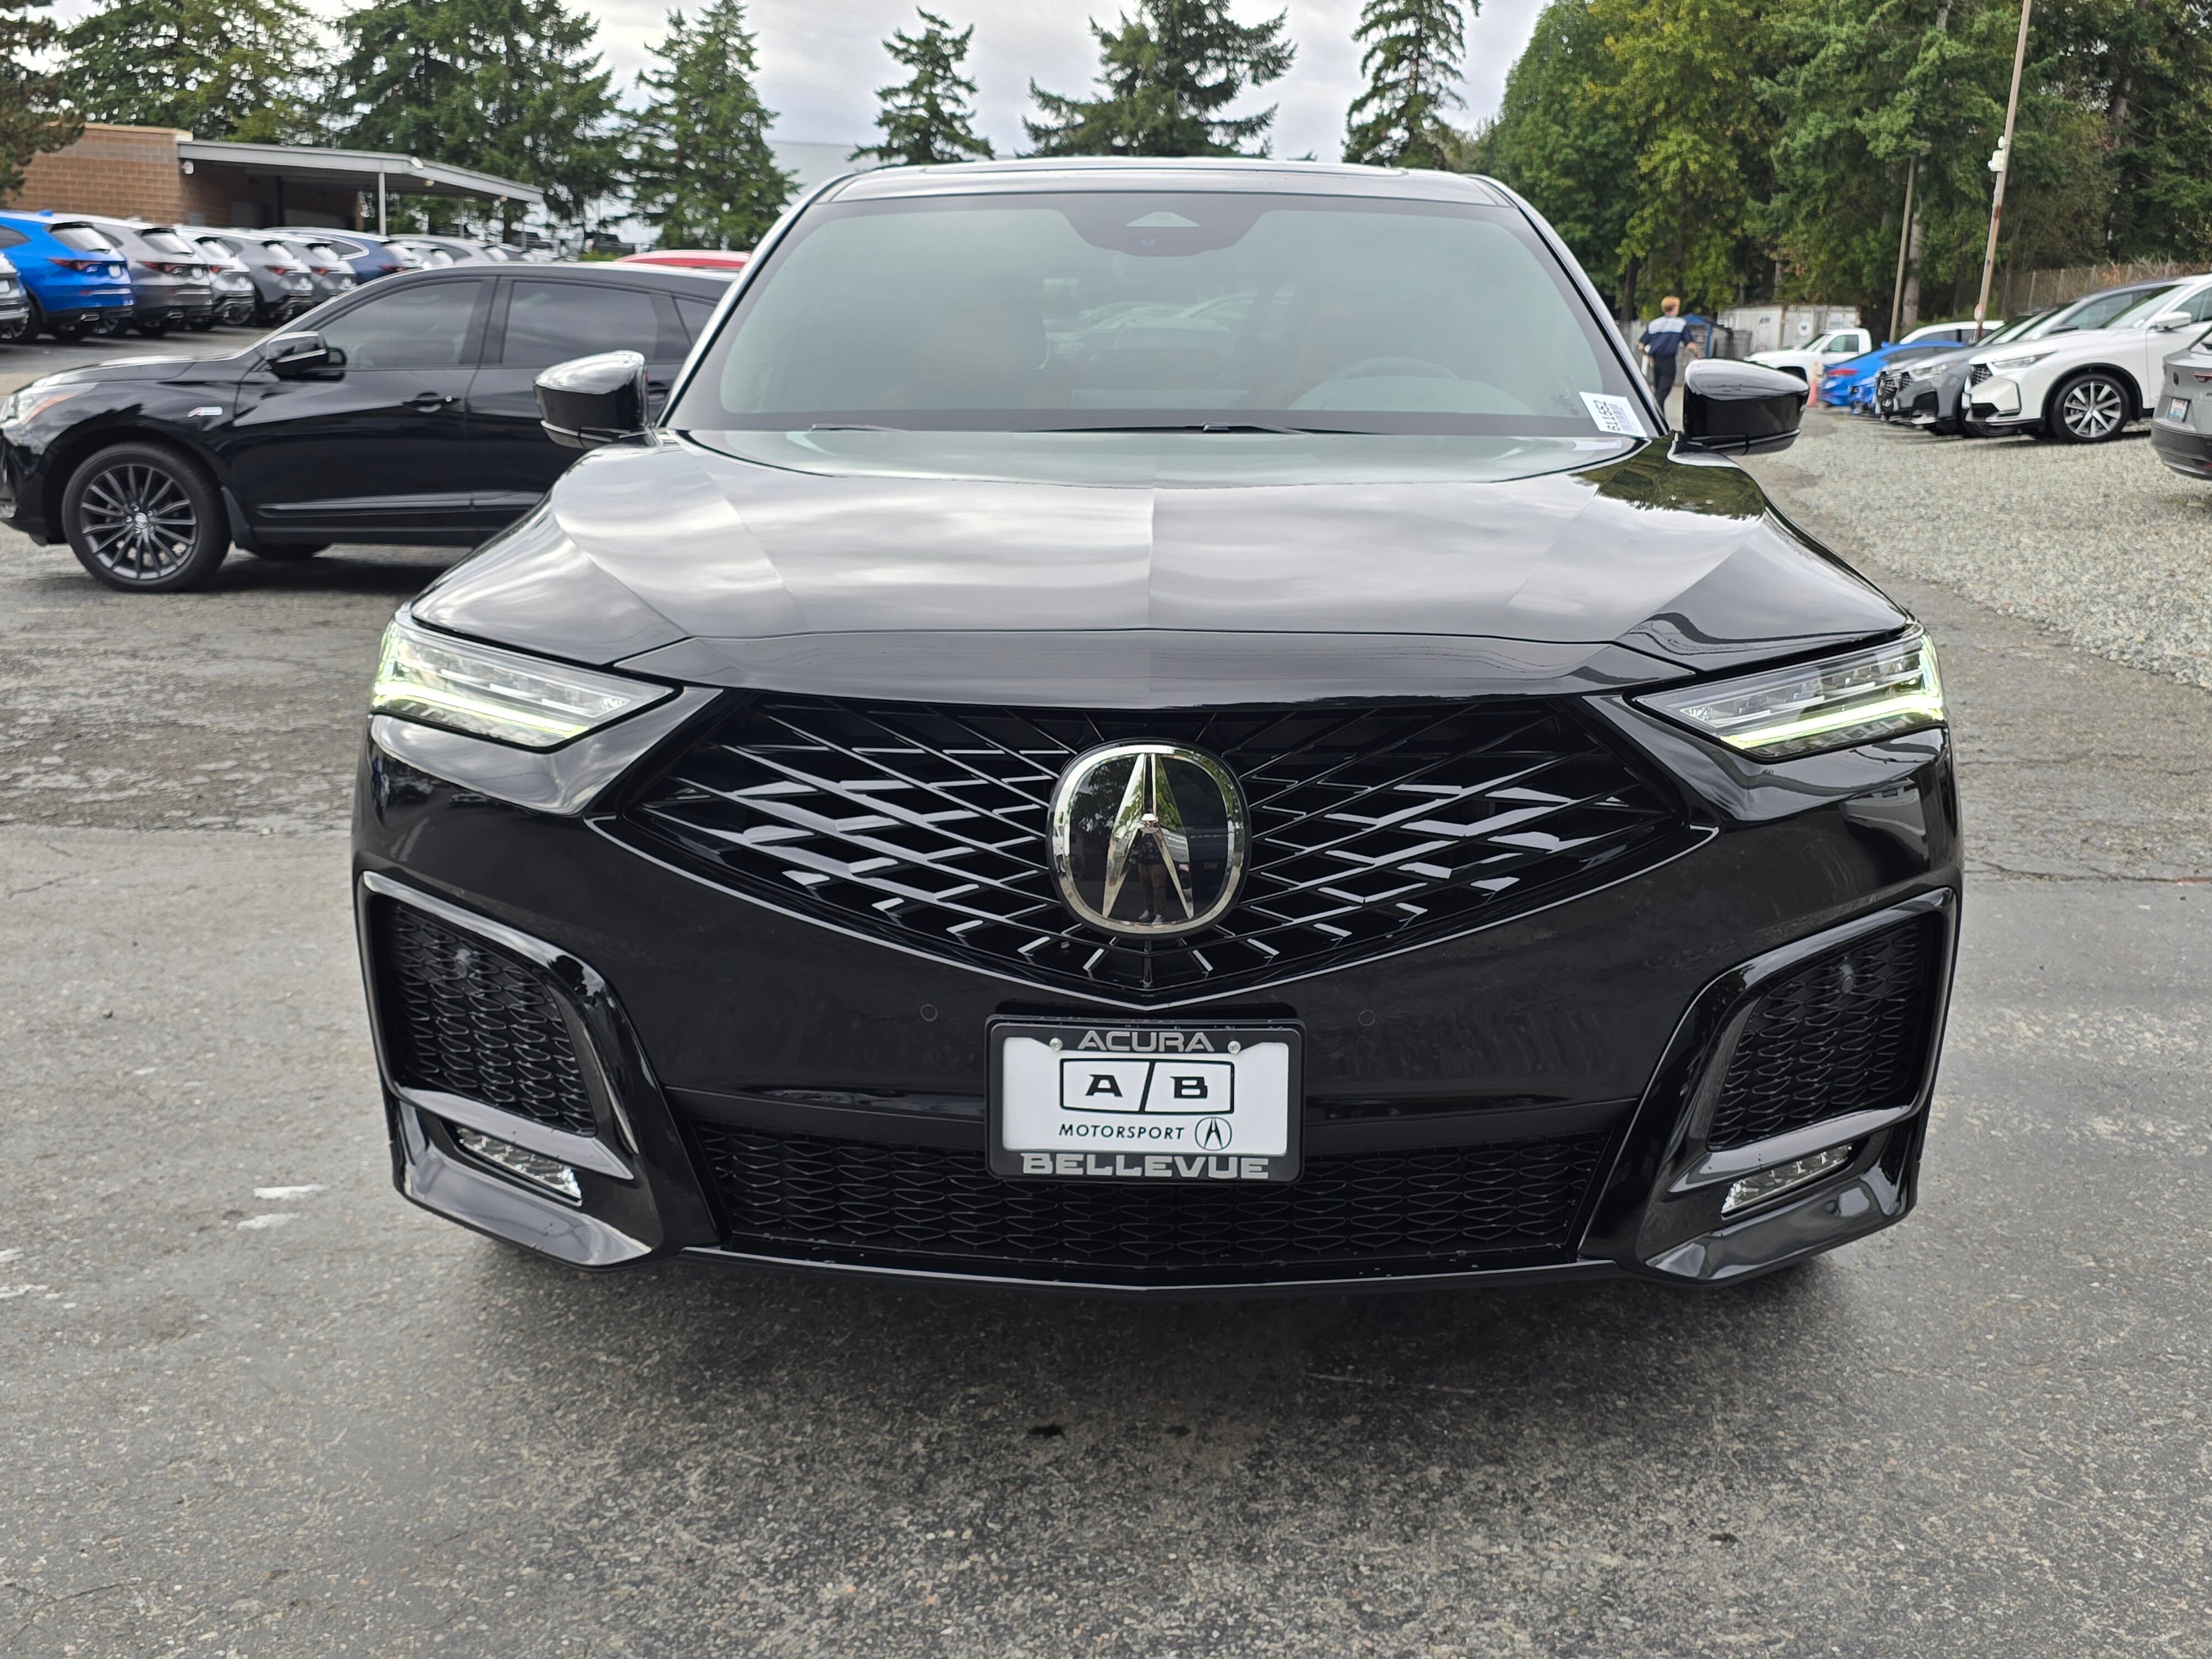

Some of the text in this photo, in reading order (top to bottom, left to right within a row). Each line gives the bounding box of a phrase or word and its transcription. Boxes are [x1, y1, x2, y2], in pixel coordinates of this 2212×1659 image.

[1077, 1030, 1214, 1052] ACURA
[1058, 1123, 1185, 1140] MOTORSPORT
[1020, 1152, 1269, 1180] BELLEVUE
